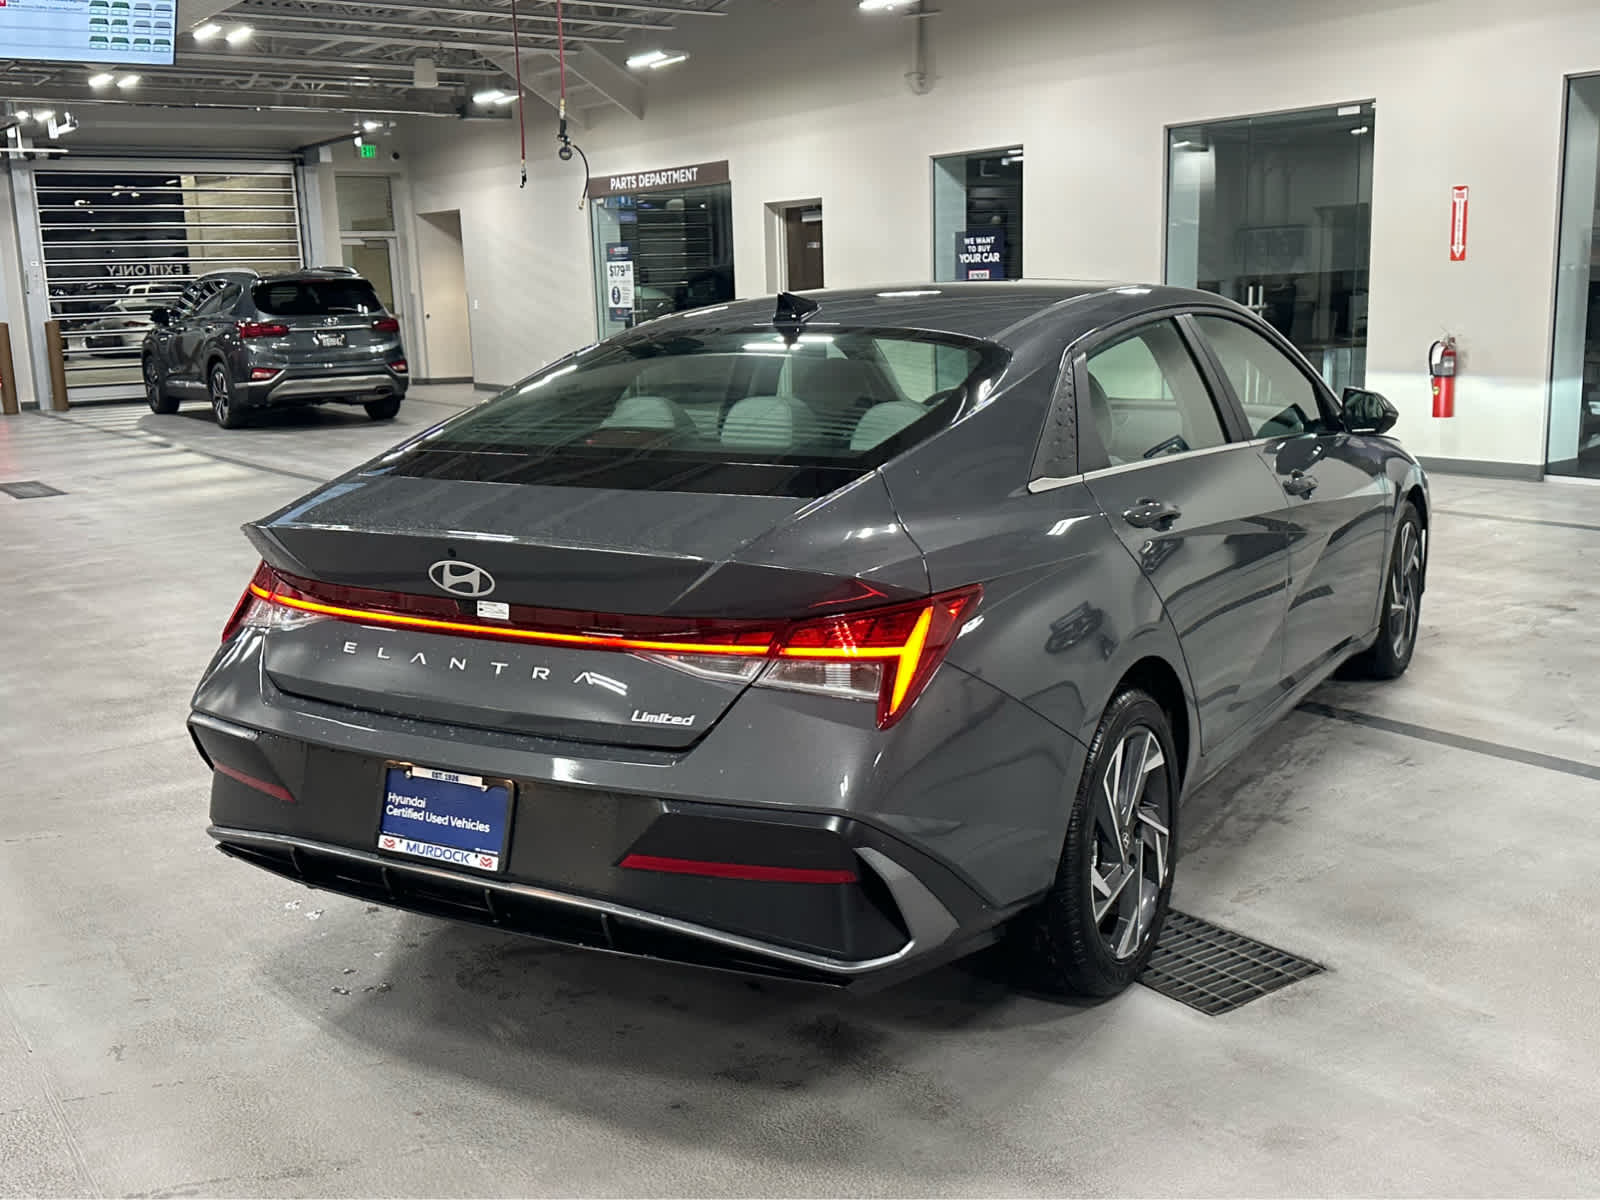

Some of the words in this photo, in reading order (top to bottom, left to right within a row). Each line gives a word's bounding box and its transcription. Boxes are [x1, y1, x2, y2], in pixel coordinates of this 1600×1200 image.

[610, 175, 637, 190] PARTS
[638, 167, 698, 187] DEPARTMENT
[976, 236, 995, 244] WANT
[978, 244, 991, 252] BUY
[959, 253, 982, 263] YOUR
[982, 252, 1000, 263] CAR
[343, 642, 599, 685] ELANTRA
[631, 709, 695, 727] Limited
[387, 792, 426, 808] Hyundai
[386, 805, 425, 821] Certified
[425, 813, 449, 825] Used
[450, 815, 490, 833] Vehicles
[406, 841, 470, 864] MURDOCK
